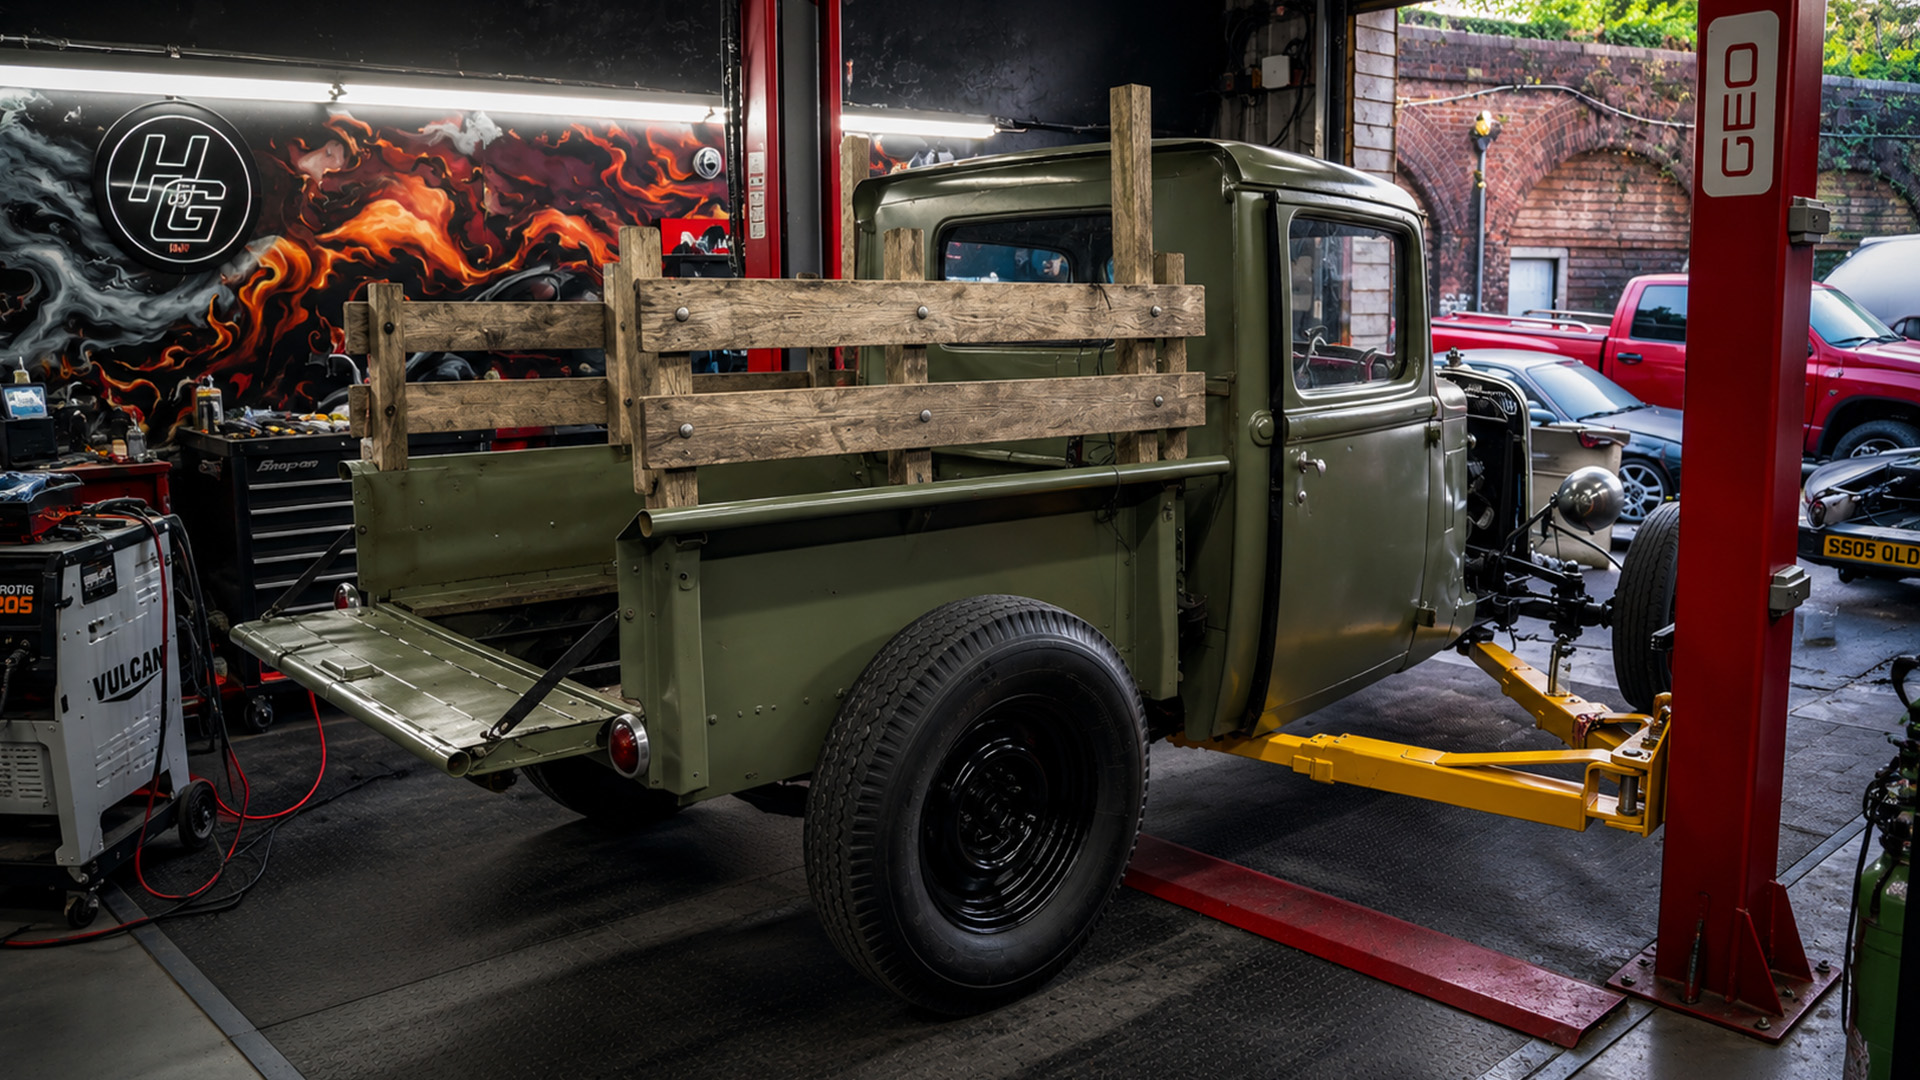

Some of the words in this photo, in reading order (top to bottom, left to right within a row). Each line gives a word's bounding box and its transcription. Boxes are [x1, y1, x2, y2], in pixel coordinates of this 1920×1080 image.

[1721, 42, 1758, 178] GEO
[1829, 538, 1876, 559] SS05
[1882, 545, 1920, 565] OLD
[92, 645, 163, 701] VULCAN
